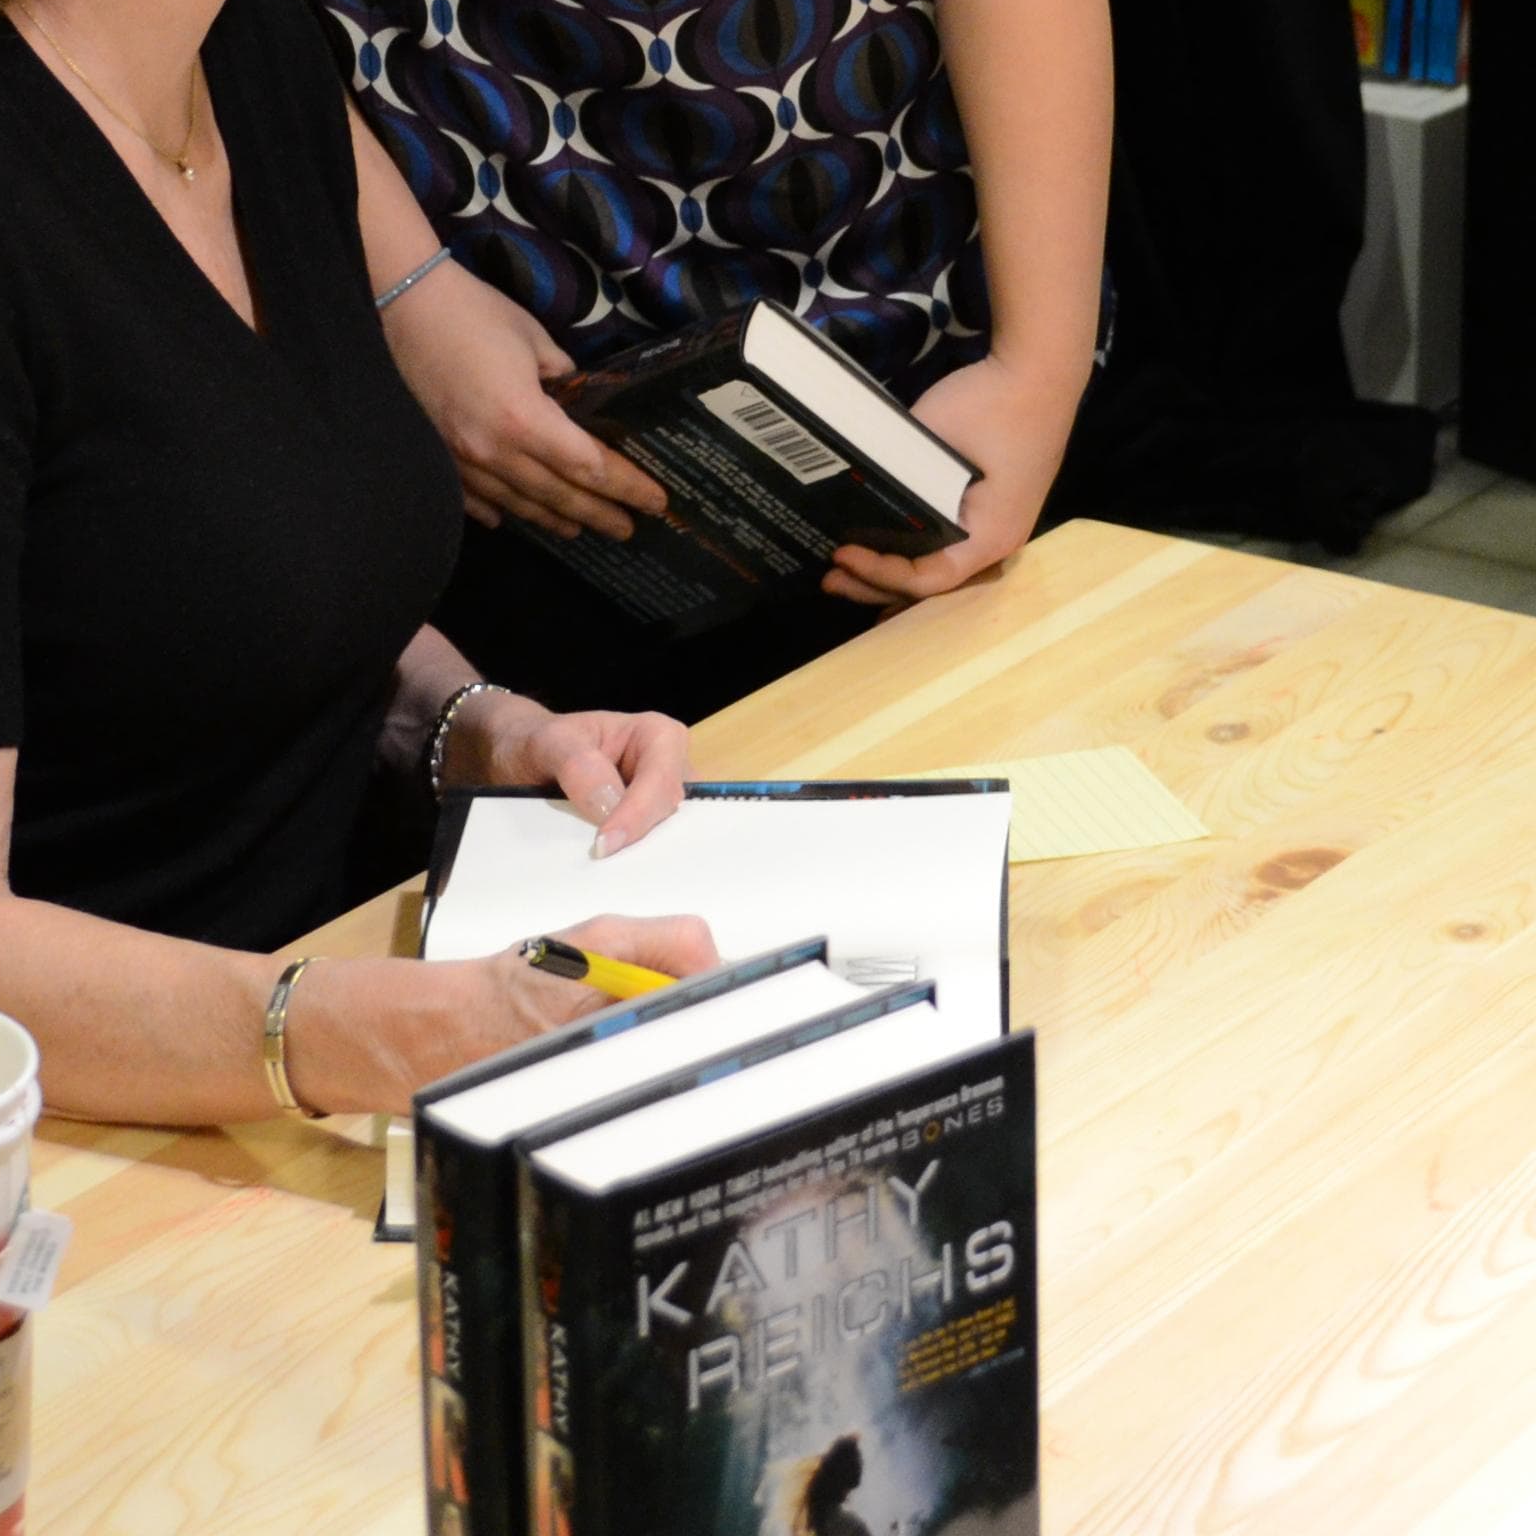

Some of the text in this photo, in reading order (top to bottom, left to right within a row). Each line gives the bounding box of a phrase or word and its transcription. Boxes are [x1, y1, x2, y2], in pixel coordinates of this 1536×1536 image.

[902, 1096, 1005, 1151] BONES
[637, 1158, 942, 1339] KATHY
[688, 1220, 1016, 1411] REICHS
